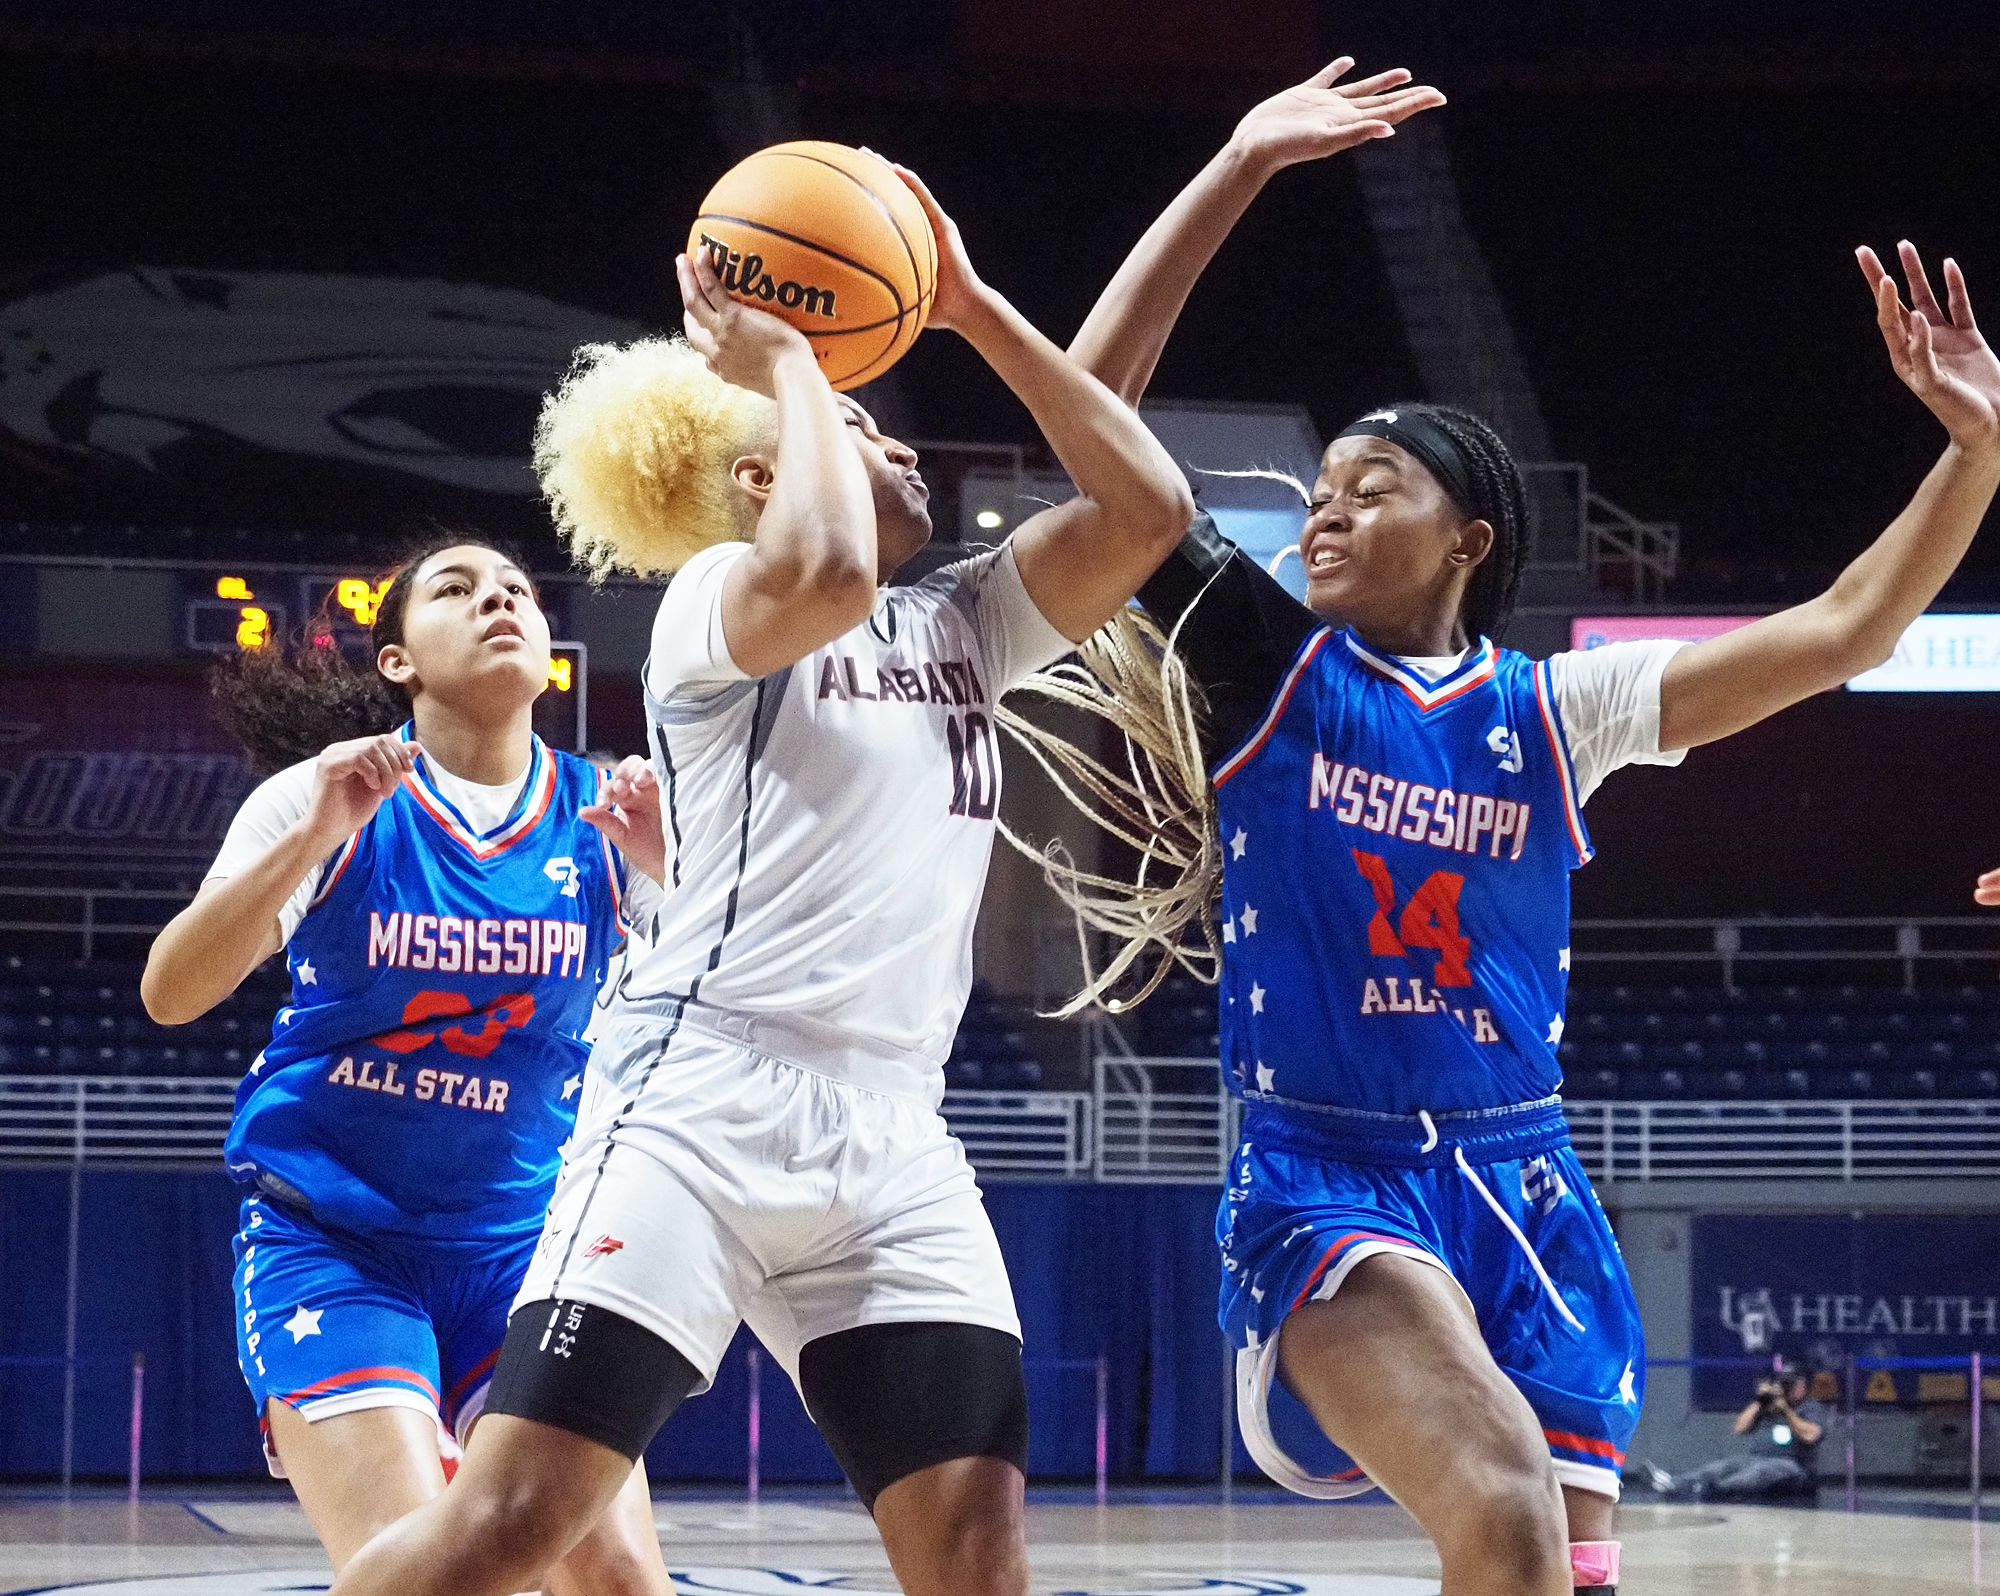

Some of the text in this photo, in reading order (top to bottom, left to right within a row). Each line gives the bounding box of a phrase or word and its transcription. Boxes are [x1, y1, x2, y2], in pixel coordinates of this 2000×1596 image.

[700, 231, 836, 318] Wilson
[947, 711, 996, 820] 10
[368, 911, 587, 980] MISSISSIPPI
[1350, 848, 1472, 987] 14
[1361, 976, 1437, 1014] ALL
[329, 1056, 510, 1113] ALL STAR
[1791, 1294, 1997, 1335] HEALTH
